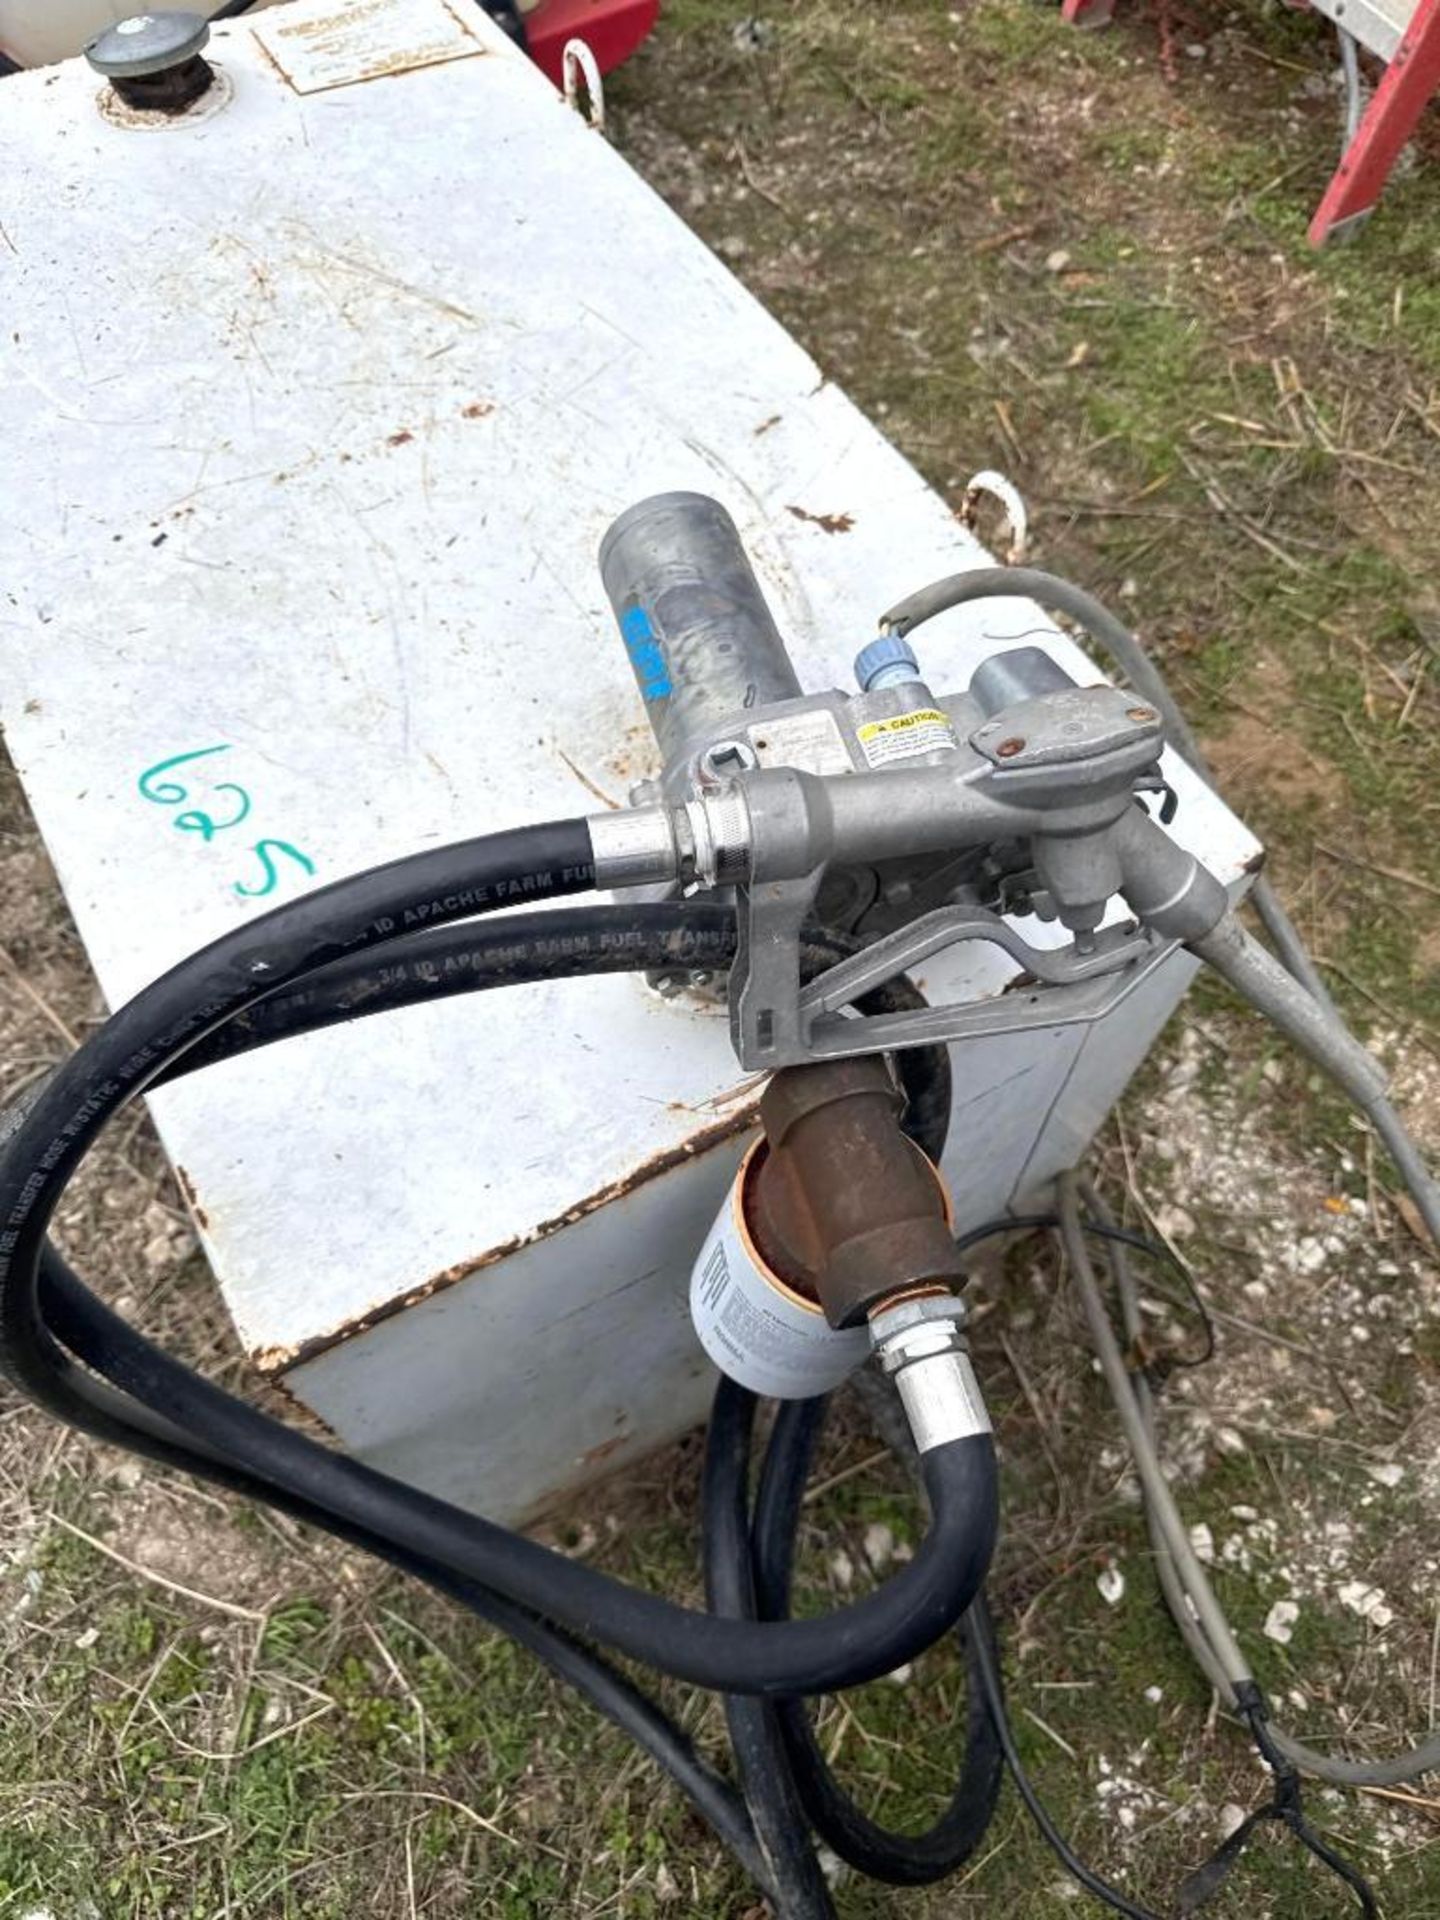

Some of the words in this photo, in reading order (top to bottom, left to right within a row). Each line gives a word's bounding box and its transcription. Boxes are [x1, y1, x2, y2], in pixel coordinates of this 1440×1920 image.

[138, 743, 317, 897] 625
[373, 916, 395, 935] ID
[403, 886, 489, 924] APACHE
[495, 871, 553, 897] FARM
[378, 966, 408, 985] 3/4
[600, 930, 648, 950] FUEL
